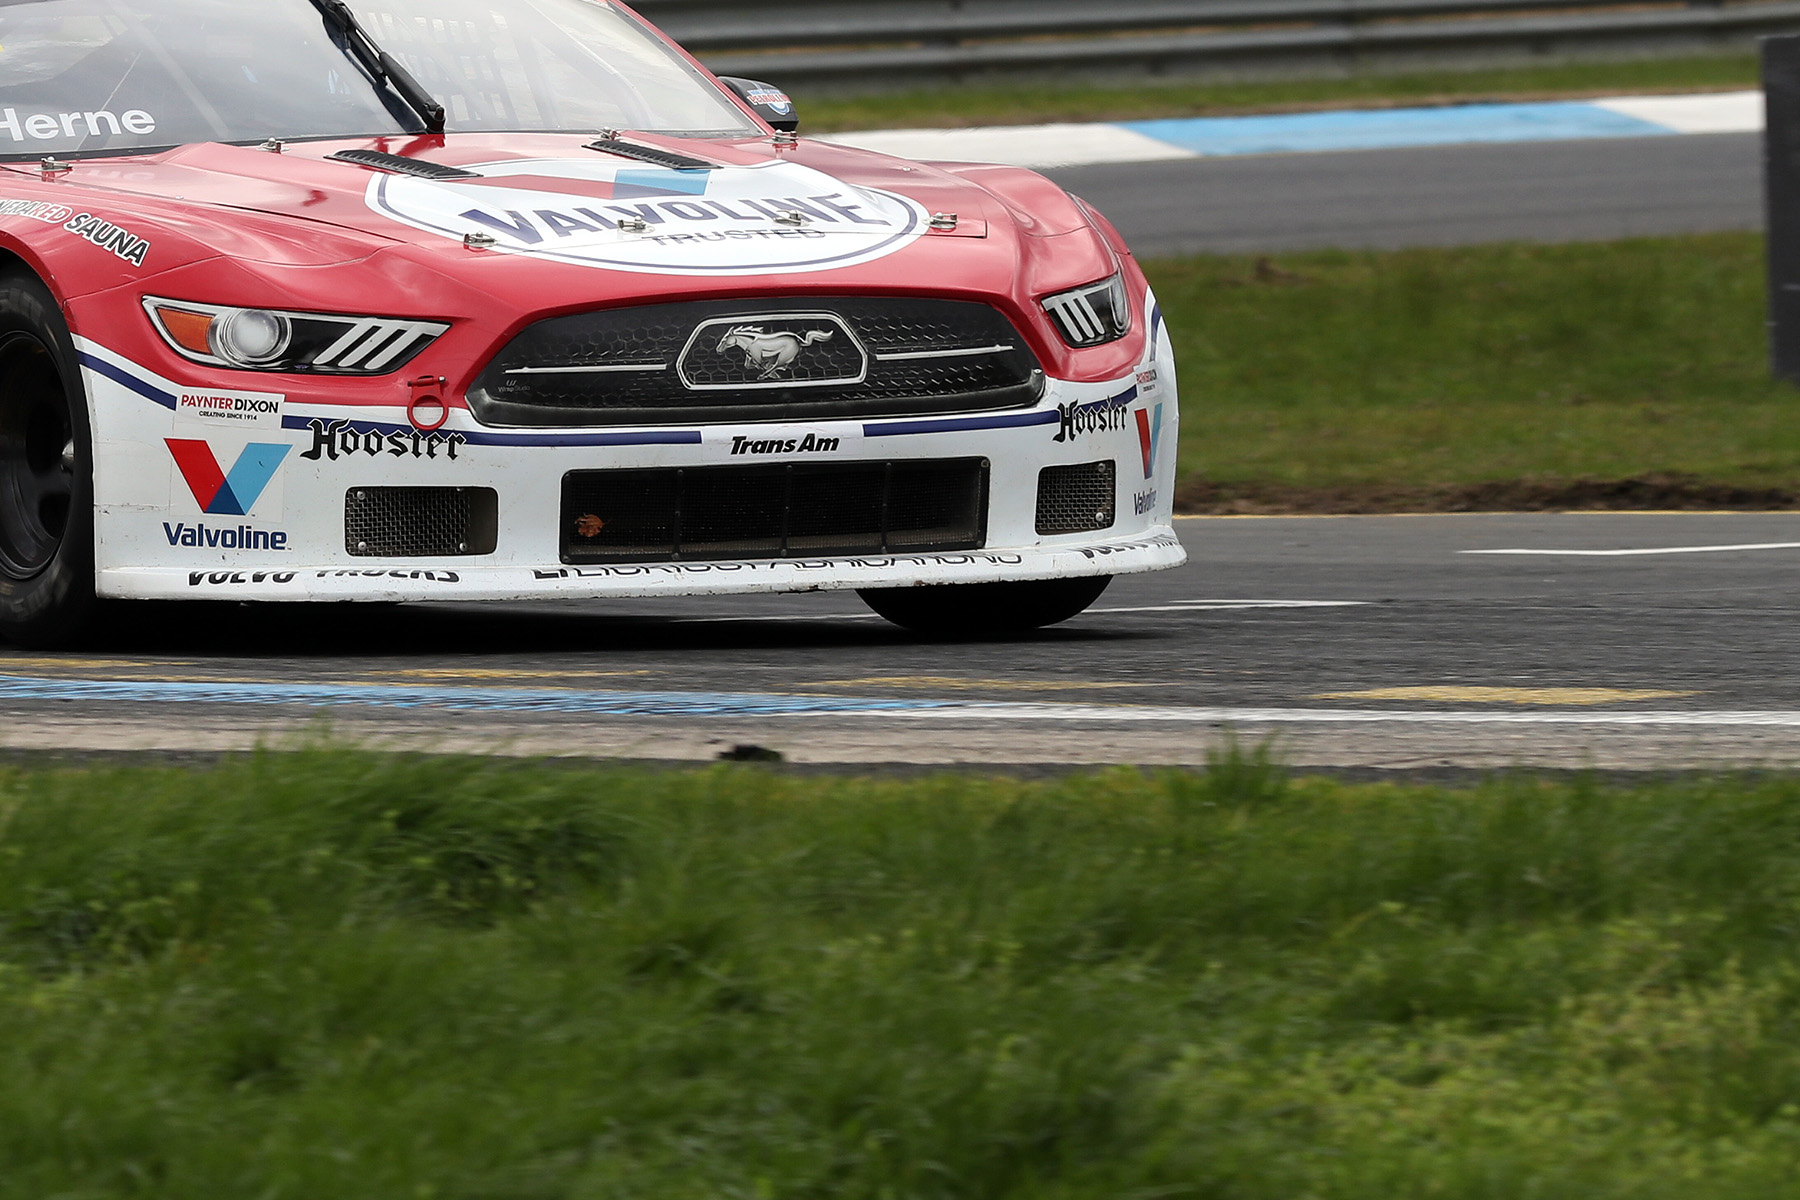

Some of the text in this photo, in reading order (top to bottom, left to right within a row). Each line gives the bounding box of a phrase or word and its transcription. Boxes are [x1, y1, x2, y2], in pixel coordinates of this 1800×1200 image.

[458, 193, 891, 245] VALVOLINE
[63, 212, 151, 267] SAUNA
[640, 227, 826, 247] TRUSTED
[181, 394, 279, 414] PAYNTER DIXON
[199, 410, 226, 418] CREATING
[226, 412, 243, 420] SINCE
[1052, 395, 1128, 443] Hoosier
[300, 417, 467, 461] Hoosier
[729, 432, 840, 455] Trans Am
[162, 521, 289, 551] Valvoline
